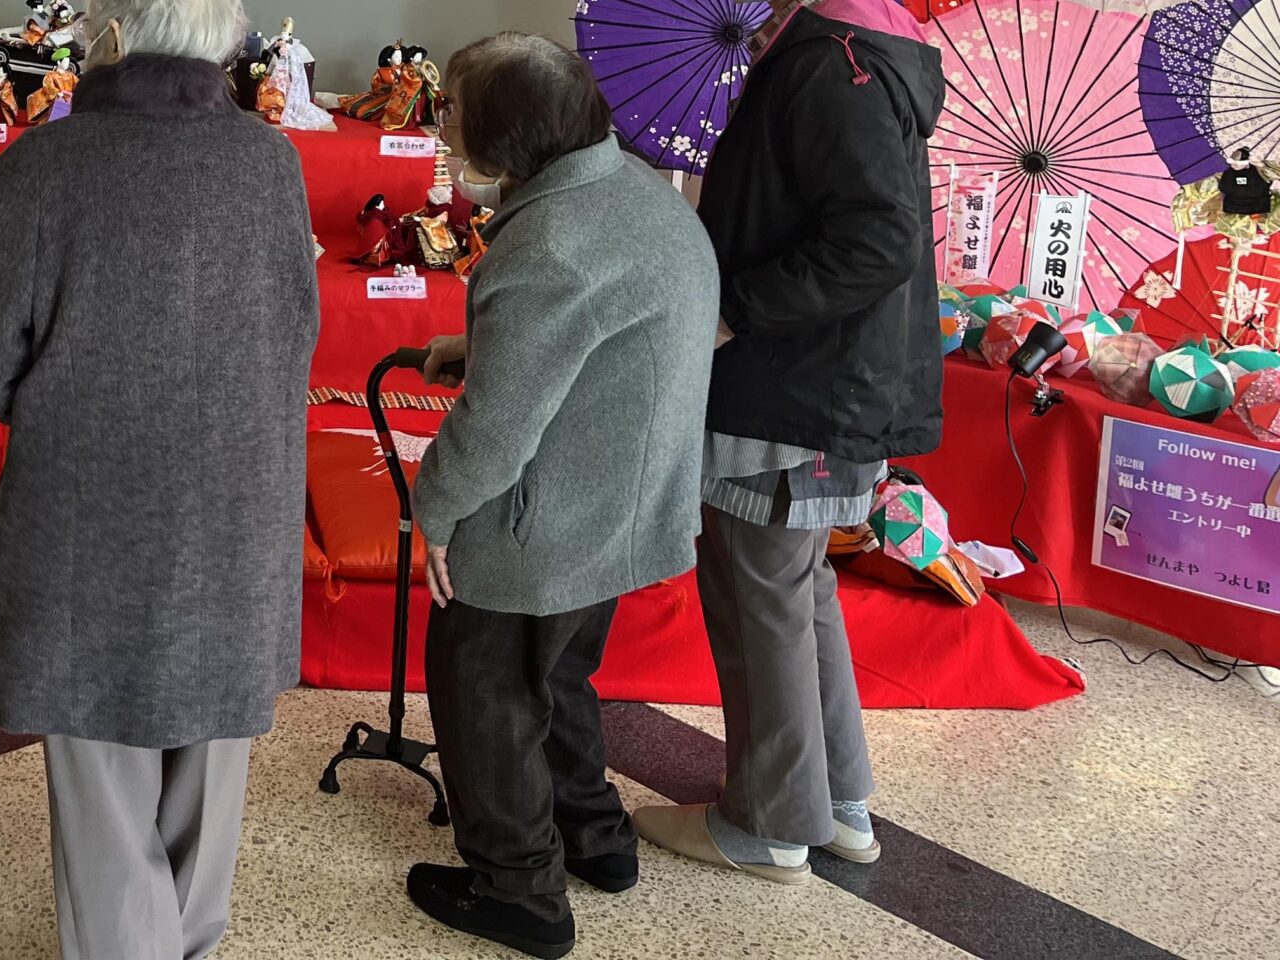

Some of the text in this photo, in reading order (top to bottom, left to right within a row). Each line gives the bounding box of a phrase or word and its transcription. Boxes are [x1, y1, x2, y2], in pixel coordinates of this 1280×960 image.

[961, 194, 984, 270] 福よせ雛
[1041, 219, 1073, 299] 火の用心
[1114, 454, 1145, 472] 第2回
[1157, 438, 1257, 471] Follow me!
[1167, 509, 1252, 538] エントリー中
[1146, 552, 1271, 595] せんまや つよし君
